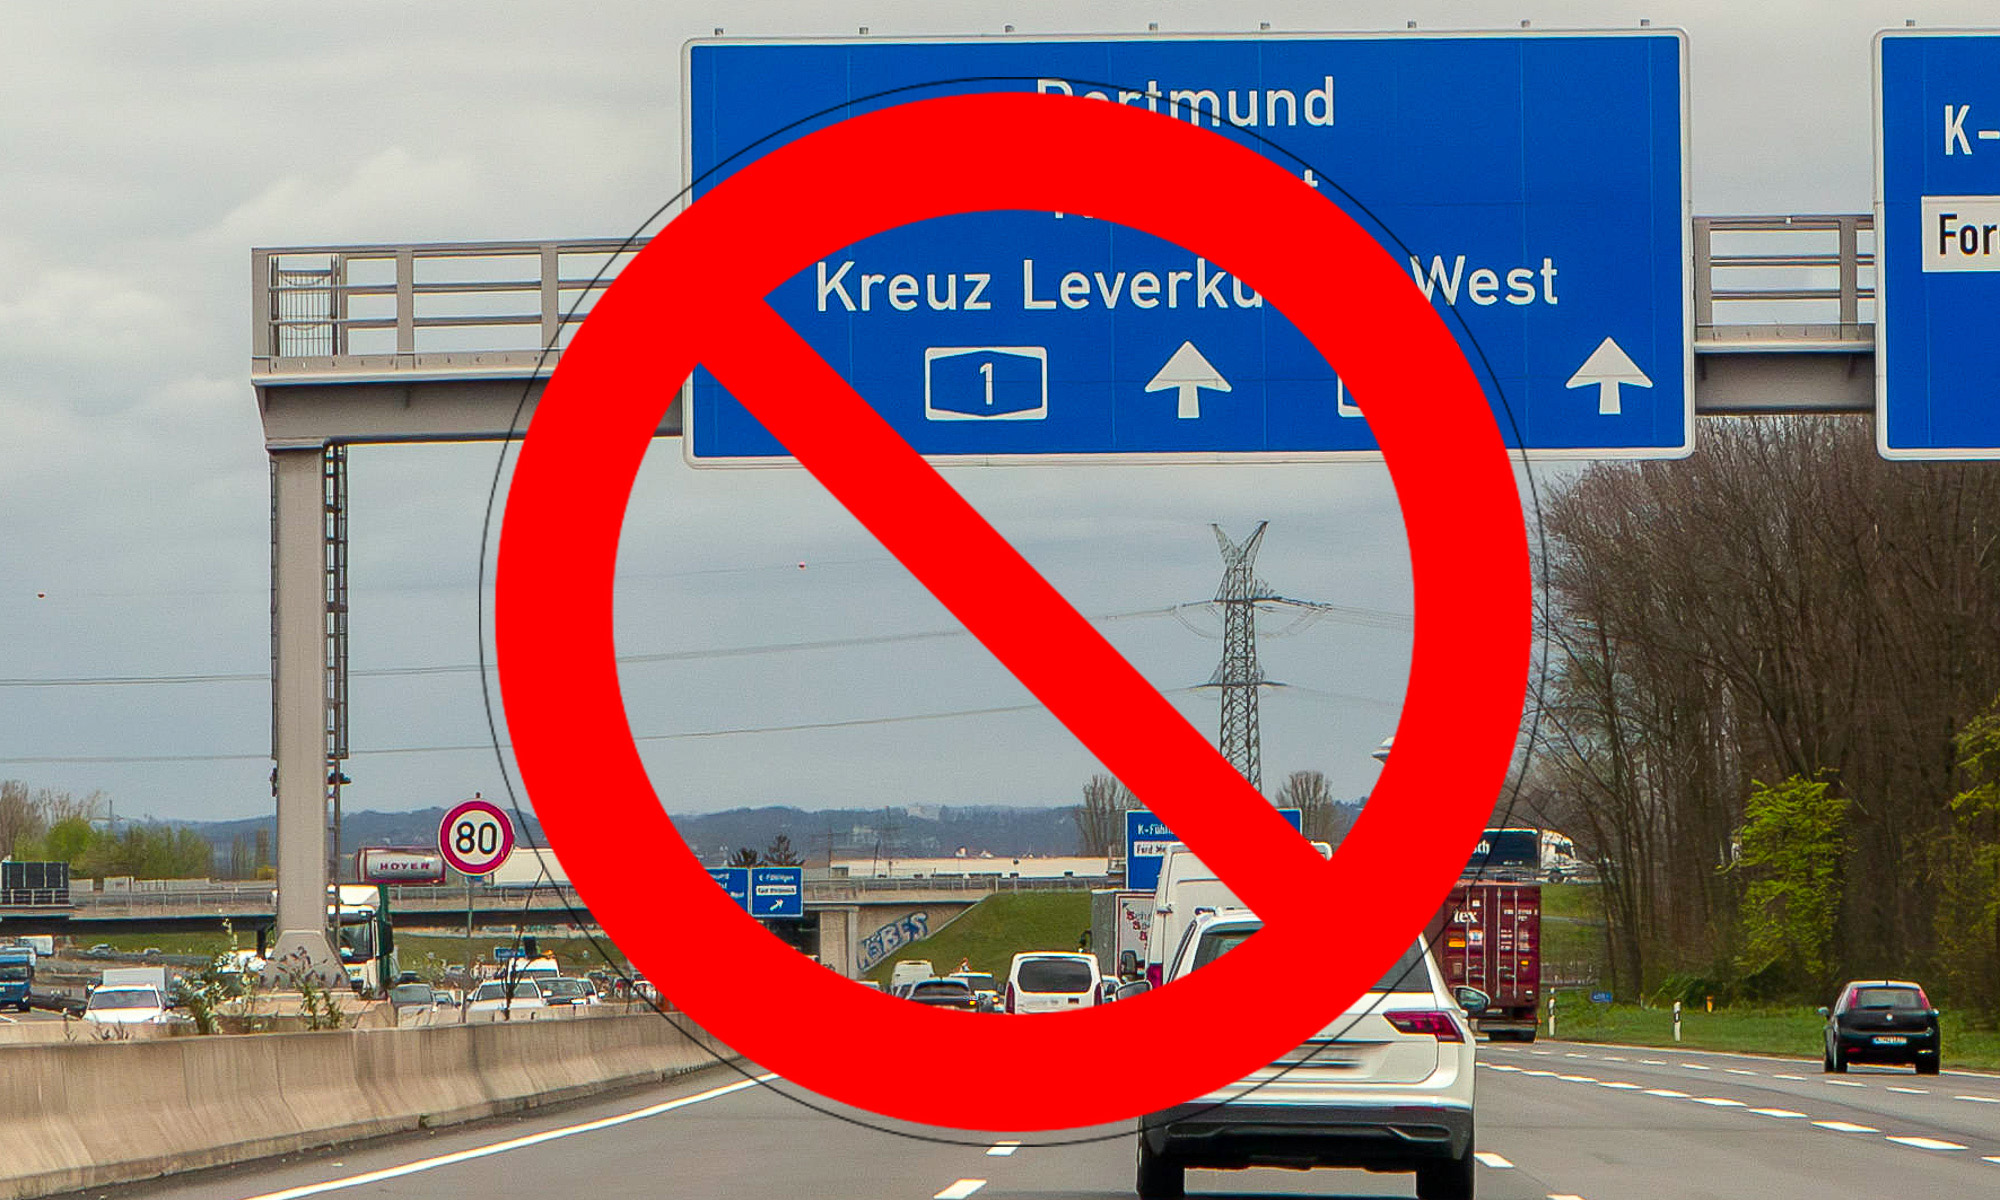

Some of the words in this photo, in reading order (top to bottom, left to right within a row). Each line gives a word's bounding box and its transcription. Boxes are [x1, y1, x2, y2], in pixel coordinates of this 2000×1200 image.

[1037, 76, 1334, 126] rtmund
[1938, 212, 2000, 257] For
[816, 261, 992, 312] Kreuz
[979, 362, 994, 406] 1
[455, 820, 498, 855] 80
[380, 862, 430, 871] HOYER
